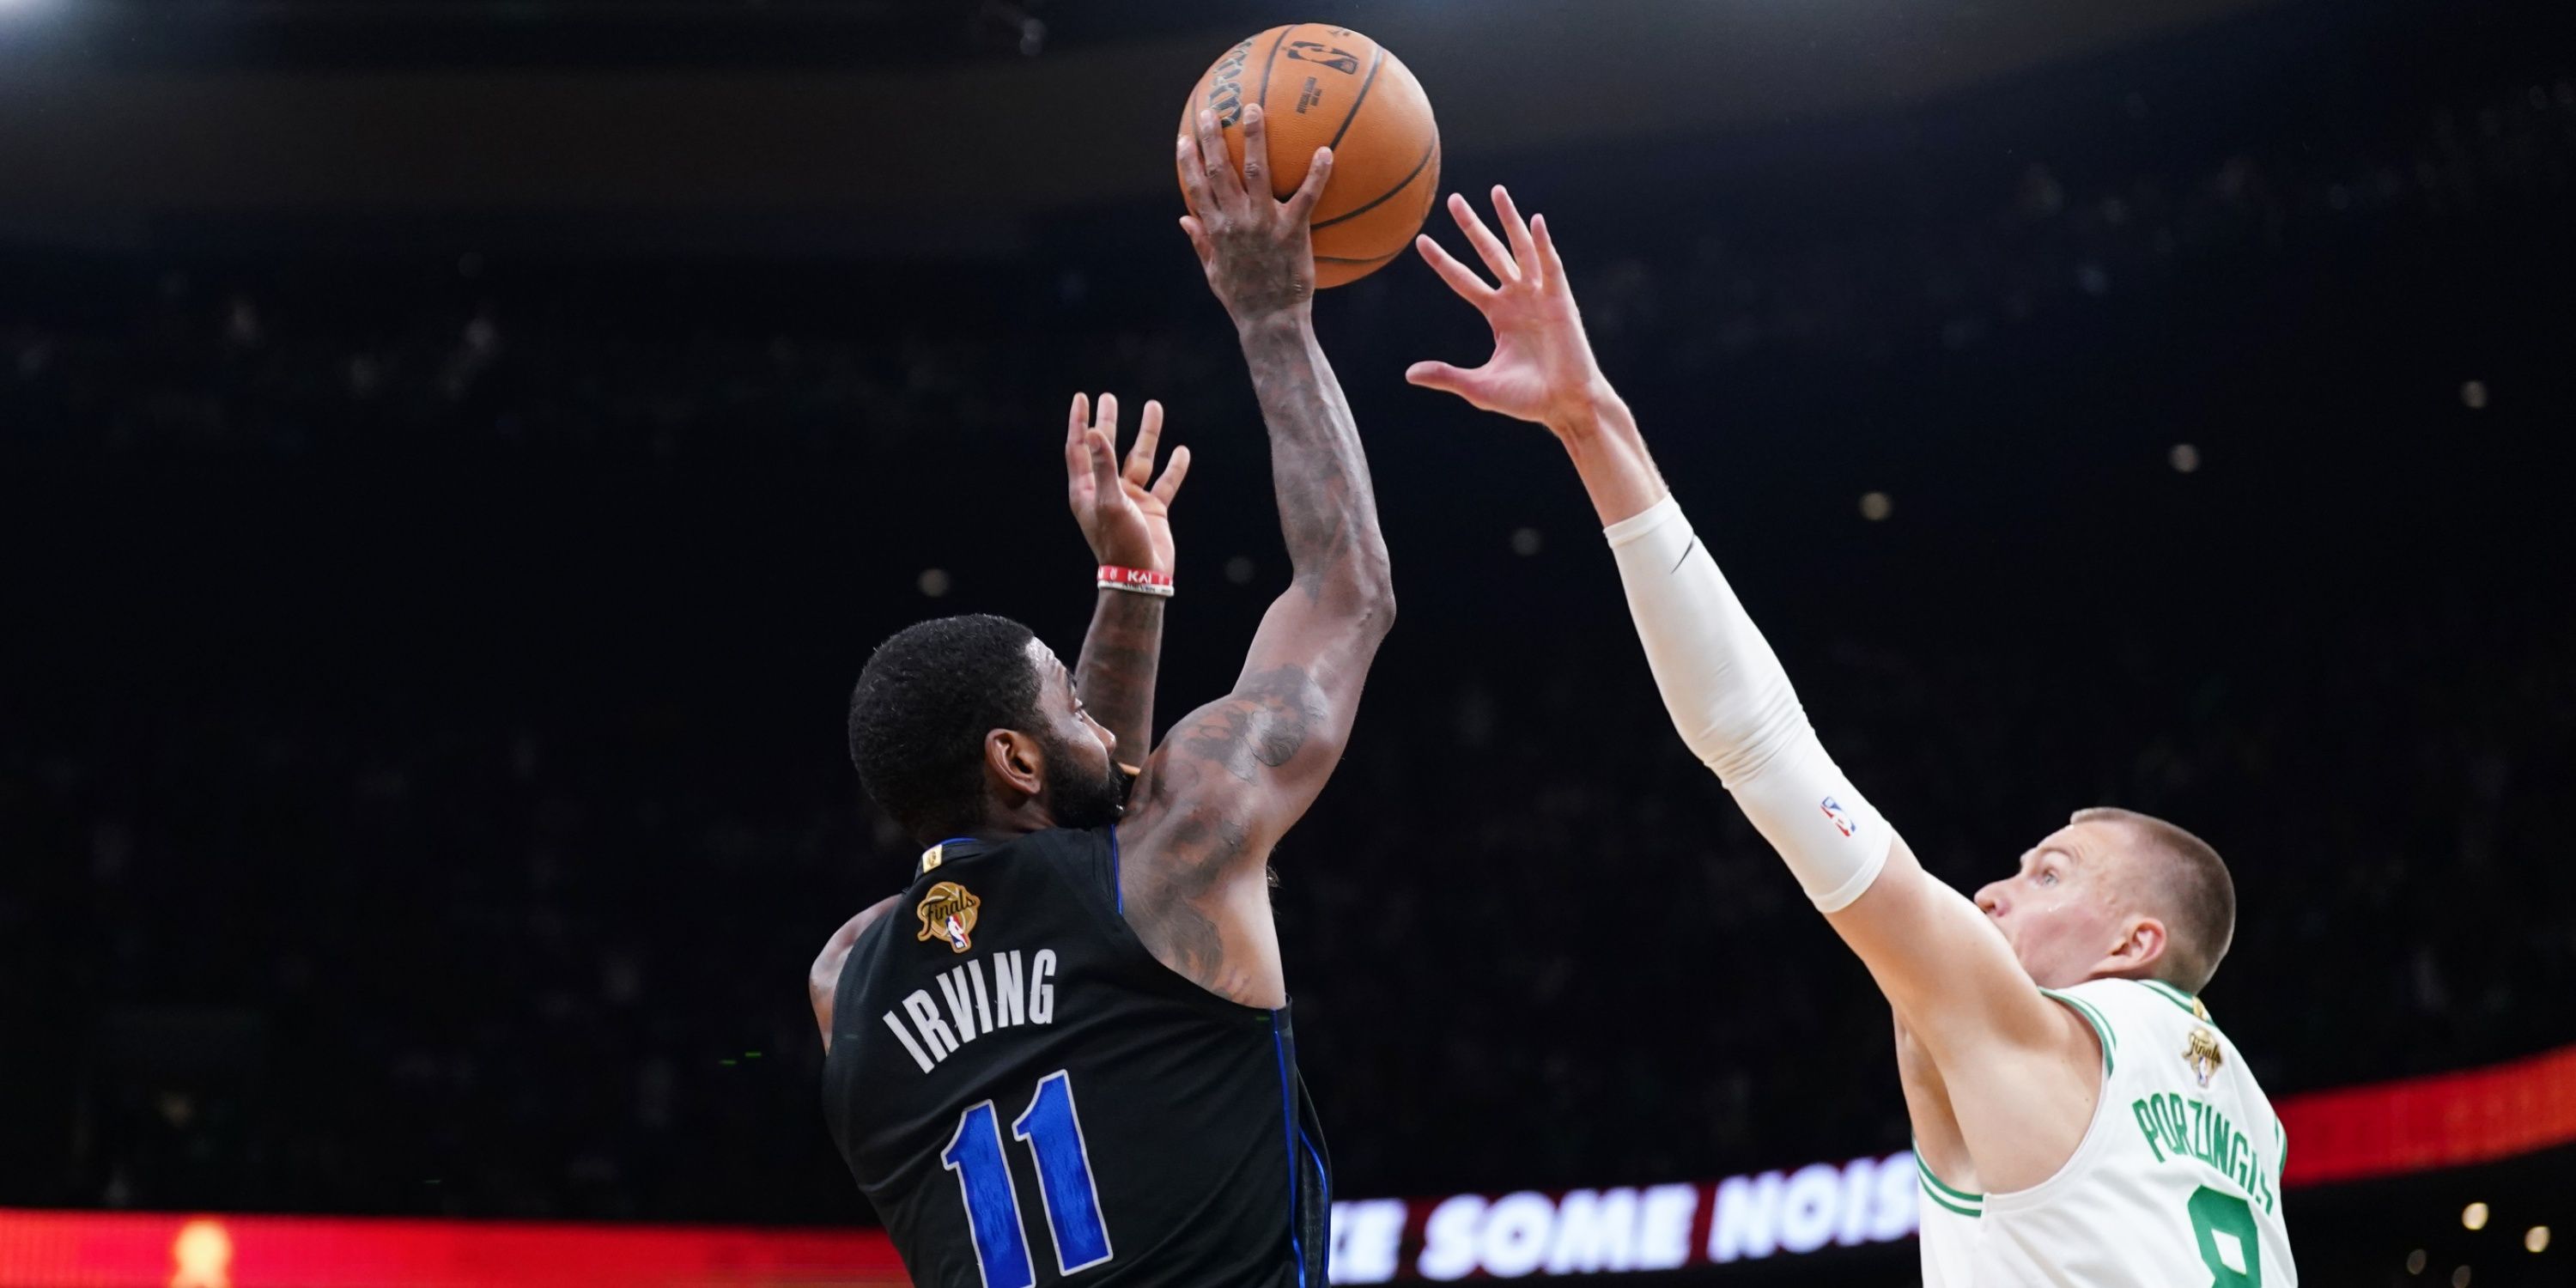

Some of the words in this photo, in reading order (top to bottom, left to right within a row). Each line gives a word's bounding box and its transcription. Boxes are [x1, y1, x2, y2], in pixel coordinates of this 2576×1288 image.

[1127, 569, 1151, 584] KAI
[919, 889, 977, 938] Finals
[883, 949, 1057, 1073] IRVING
[940, 1069, 1113, 1288] 11
[2132, 1092, 2274, 1216] PORZINGIS
[1416, 1182, 1698, 1282] SOME
